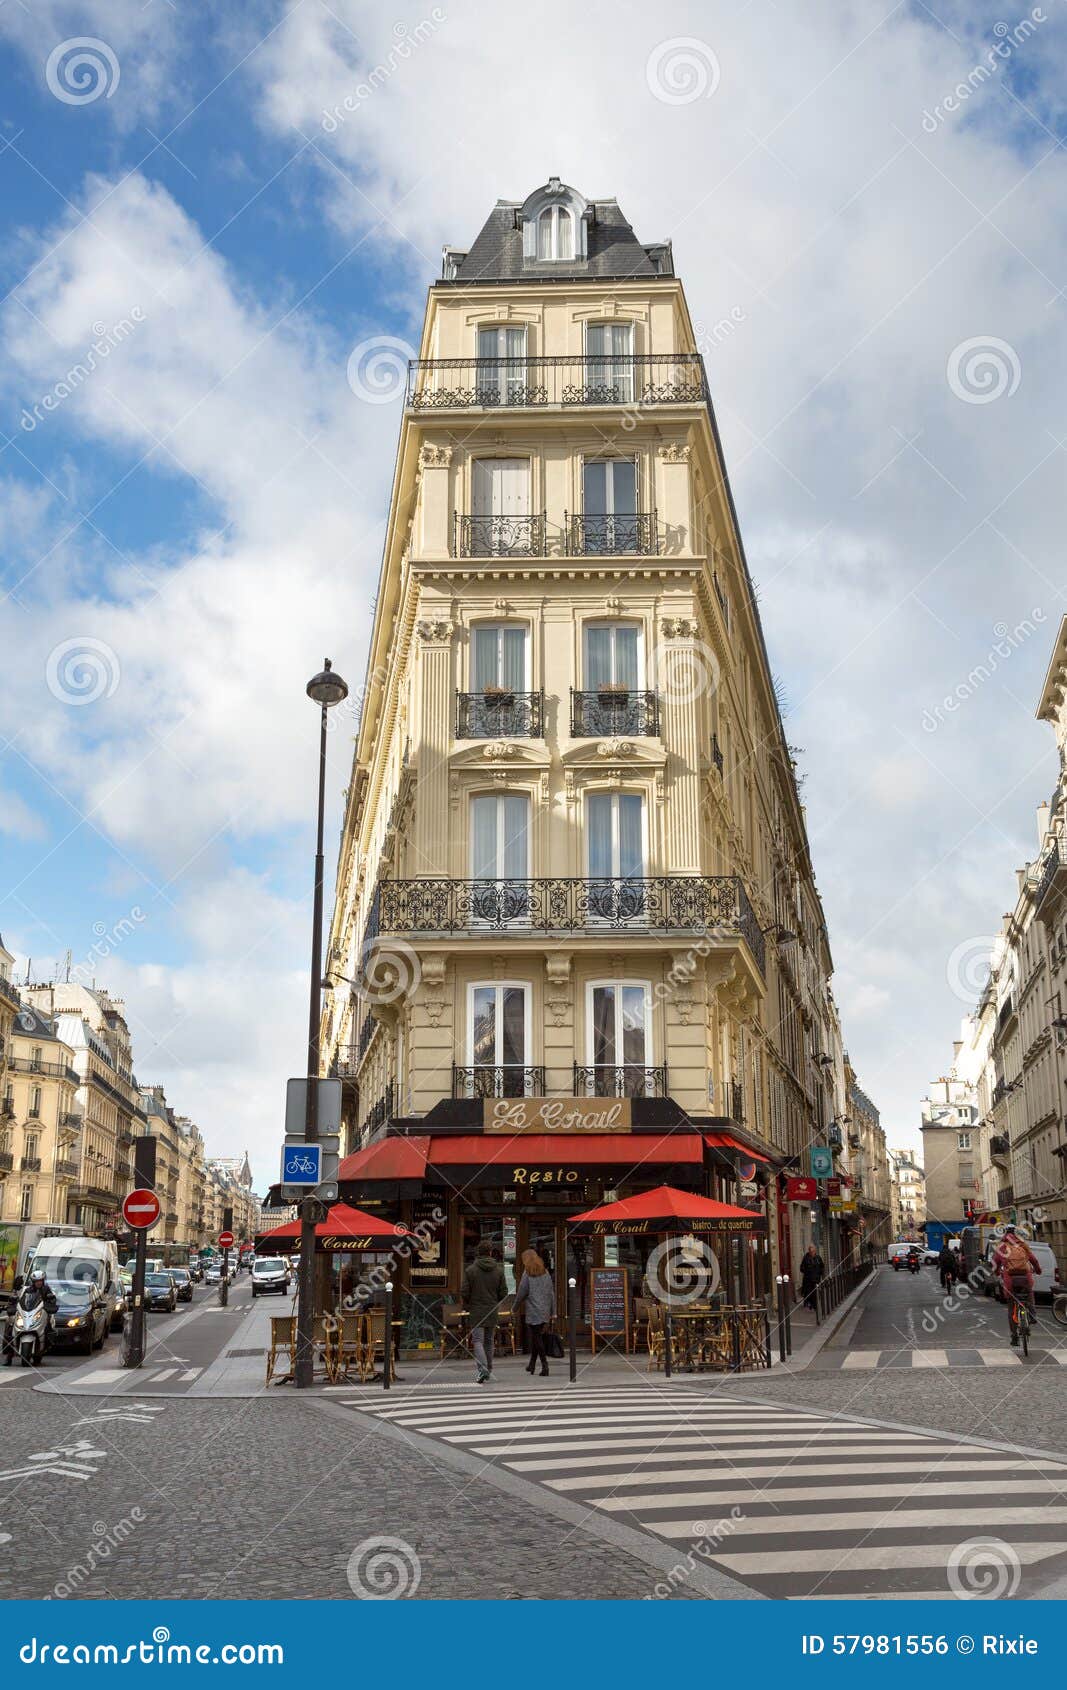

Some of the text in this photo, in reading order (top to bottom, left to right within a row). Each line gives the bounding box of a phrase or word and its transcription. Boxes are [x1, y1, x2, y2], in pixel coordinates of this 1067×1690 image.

[492, 1101, 622, 1129] Le Corail
[593, 1220, 649, 1235] Le Corail
[727, 1220, 754, 1232] quartier
[321, 1236, 373, 1249] Corail
